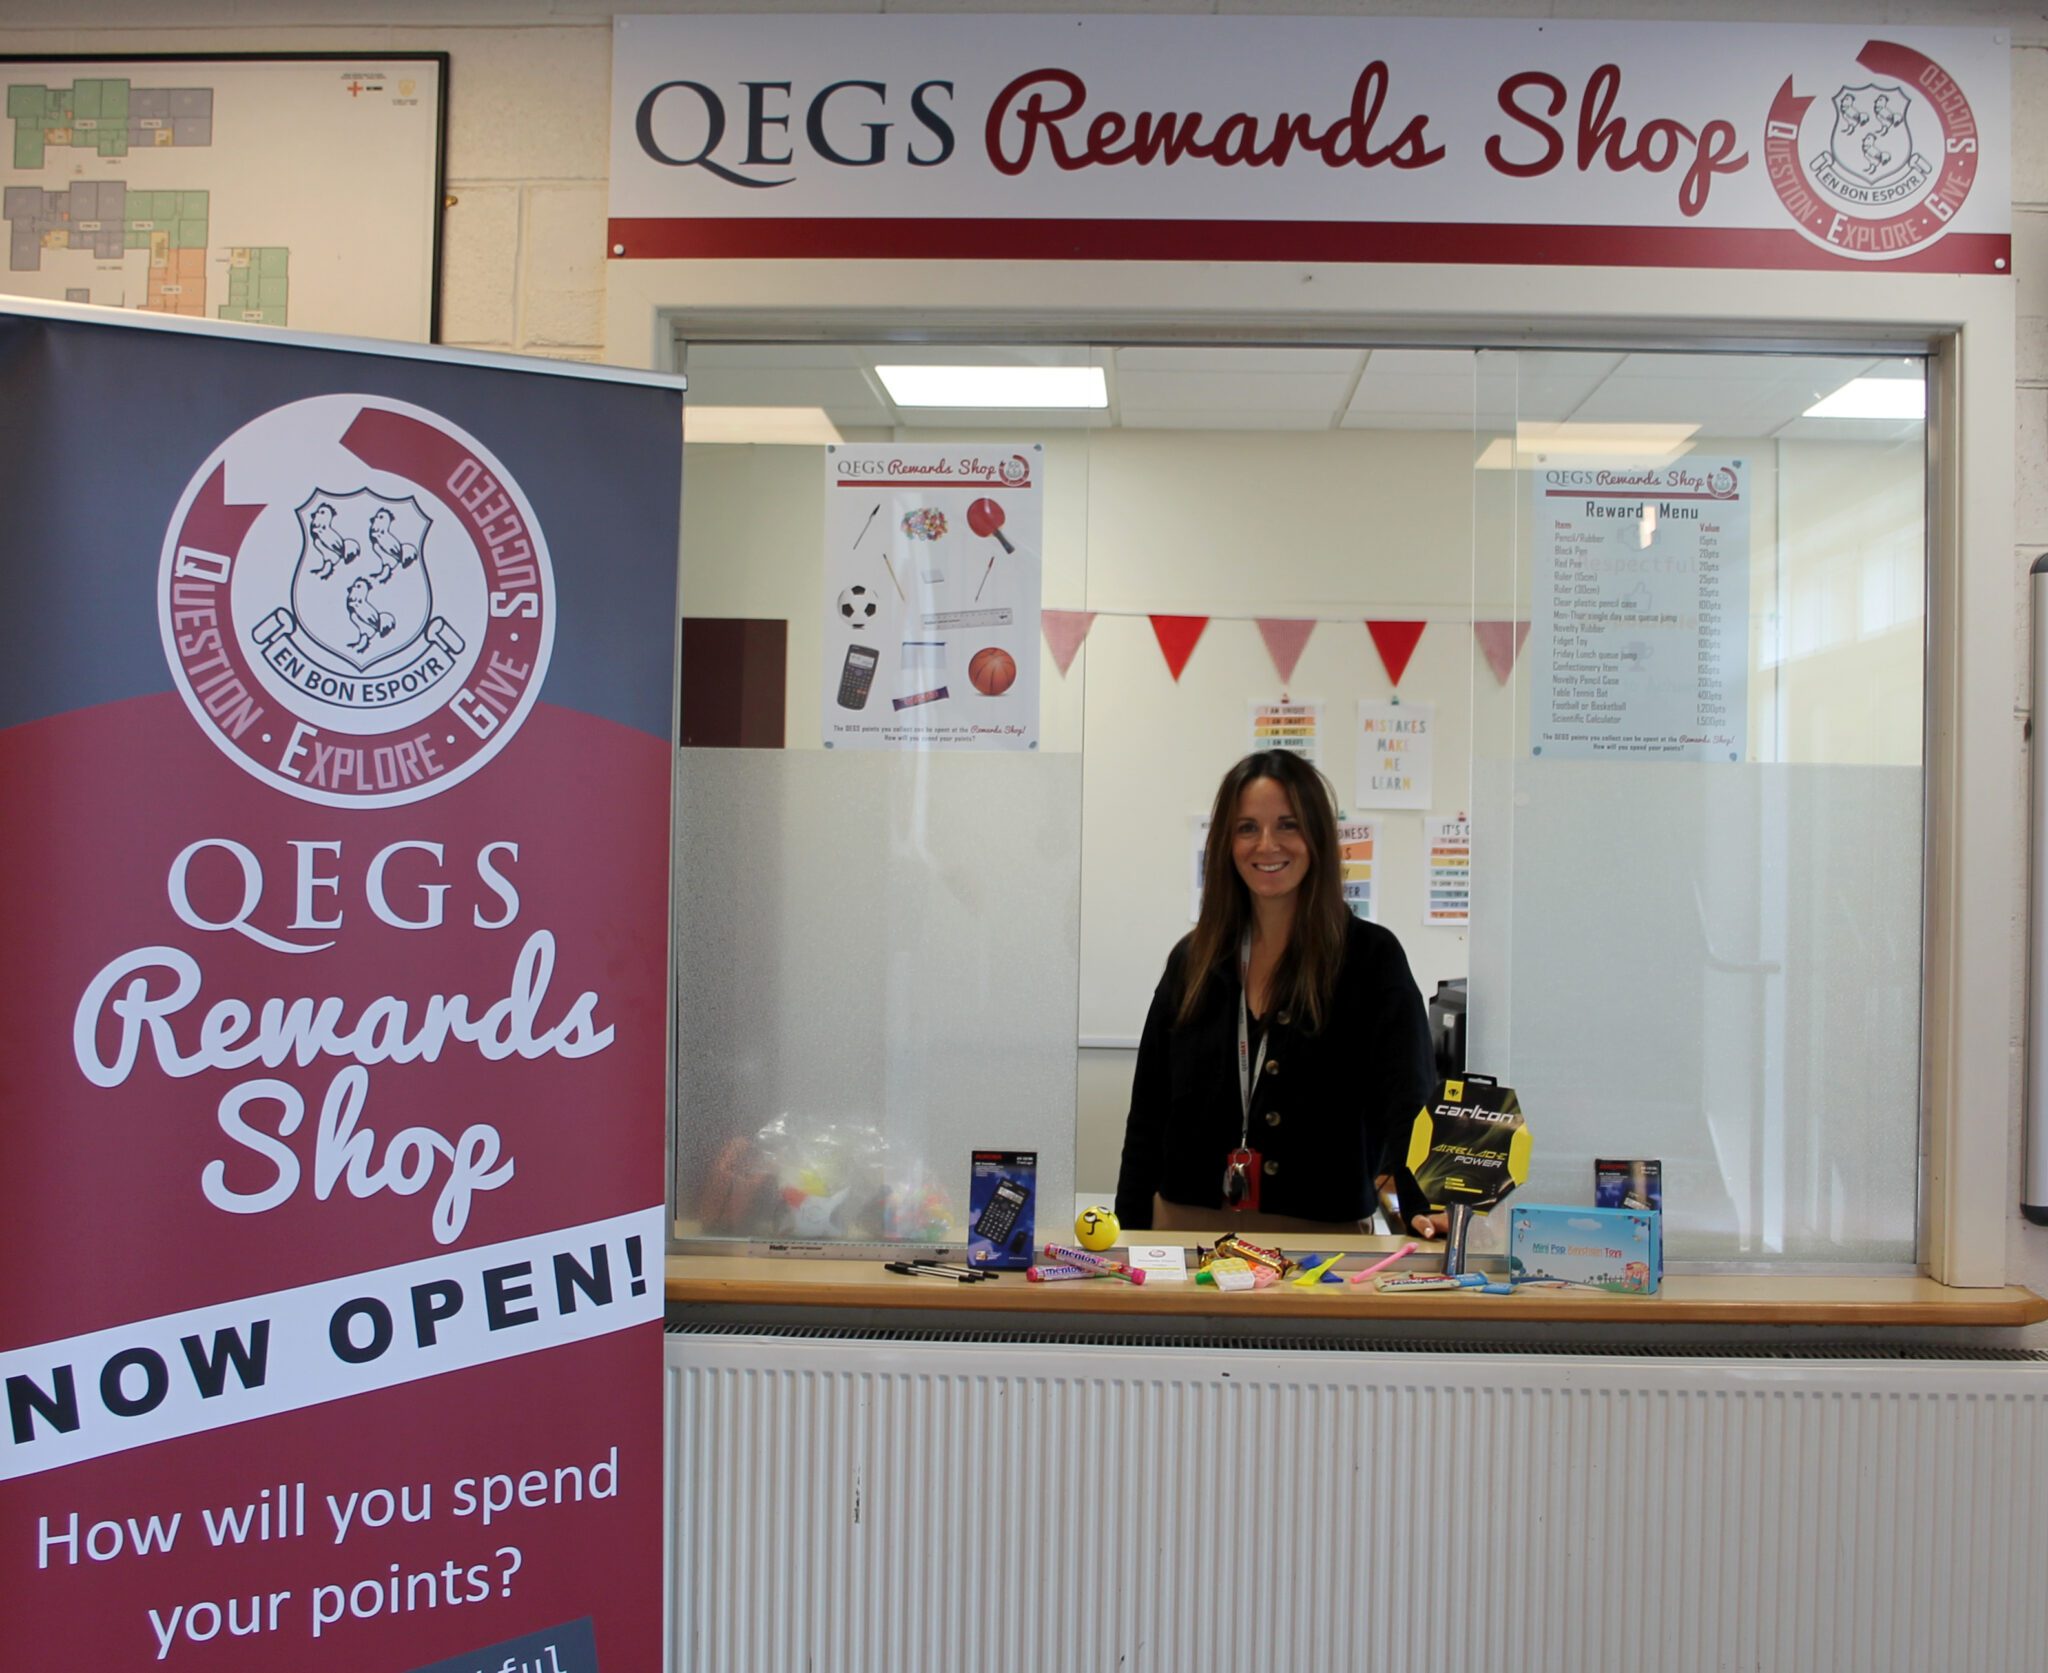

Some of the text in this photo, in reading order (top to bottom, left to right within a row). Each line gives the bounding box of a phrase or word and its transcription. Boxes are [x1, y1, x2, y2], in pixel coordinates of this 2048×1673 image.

[1919, 64, 1977, 153] SUCCEED
[635, 60, 1749, 217] QEGS Rewards Shop
[1765, 121, 1817, 223] QUESTION
[1823, 173, 1921, 202] EN BON ESPOYR
[1924, 171, 1971, 223] GIVE
[1826, 213, 1922, 253] EXPLORE
[838, 460, 884, 477] QEGS
[888, 458, 953, 475] Rewards
[958, 458, 996, 480] Shop
[1546, 470, 1592, 486] QEGS
[1596, 470, 1661, 486] Rewards
[1666, 471, 1704, 492] Shop
[1586, 501, 1698, 520] Reward Menu
[1554, 521, 1720, 533] Item Value
[446, 458, 538, 619] SUCCEED
[1554, 533, 1604, 544] Pencil/Rubber
[1554, 546, 1572, 556] Black
[1554, 559, 1568, 568] Red
[1554, 572, 1572, 582] Ruler
[1554, 584, 1572, 594] Ruler
[1554, 598, 1572, 608] Clear
[1574, 599, 1597, 610] plastic
[1599, 600, 1620, 610] pencil
[1610, 612, 1622, 623] day
[1624, 614, 1636, 622] use
[1638, 614, 1658, 624] queue
[1660, 614, 1678, 624] jump
[1553, 624, 1578, 634] Novelty
[1580, 624, 1606, 634] Rubber
[173, 545, 263, 739] QUESTION
[1553, 636, 1574, 647] Fidget
[1576, 637, 1588, 647] Toy
[1553, 650, 1574, 660] Friday
[1576, 650, 1598, 659] Lunch
[273, 647, 445, 702] EN BON ESPOYR
[1553, 662, 1618, 673] Confectionery Item
[1552, 676, 1578, 686] Novelty
[1579, 676, 1600, 686] Pencil
[1602, 677, 1620, 686] Case
[449, 649, 530, 740] GIVE
[1552, 688, 1570, 698] Table
[1572, 688, 1594, 698] Tennis
[1596, 689, 1608, 698] Bat
[1552, 701, 1580, 711] Football
[1590, 702, 1626, 712] Basketball
[1364, 719, 1426, 734] MISTAKES
[1552, 714, 1584, 724] Scientific
[1586, 714, 1622, 724] Calculator
[1377, 738, 1409, 752] MAKE
[278, 721, 445, 792] EXPLORE
[1384, 758, 1400, 772] ME
[1372, 776, 1411, 790] LEARN
[1442, 824, 1461, 836] IT'S
[167, 838, 521, 954] QEGS
[73, 929, 615, 1088] Rewards
[1434, 1104, 1514, 1124] carlton
[201, 1064, 515, 1246] Shop
[1432, 1143, 1508, 1160] AIRBLADE
[1454, 1155, 1503, 1168] POWER
[1058, 1248, 1096, 1264] mentos
[1532, 1242, 1548, 1254] Mini
[1550, 1244, 1566, 1255] Pop
[5, 1234, 647, 1445] NOW OPEN!
[37, 1446, 619, 1570] How will you spend
[148, 1545, 524, 1660] your points?
